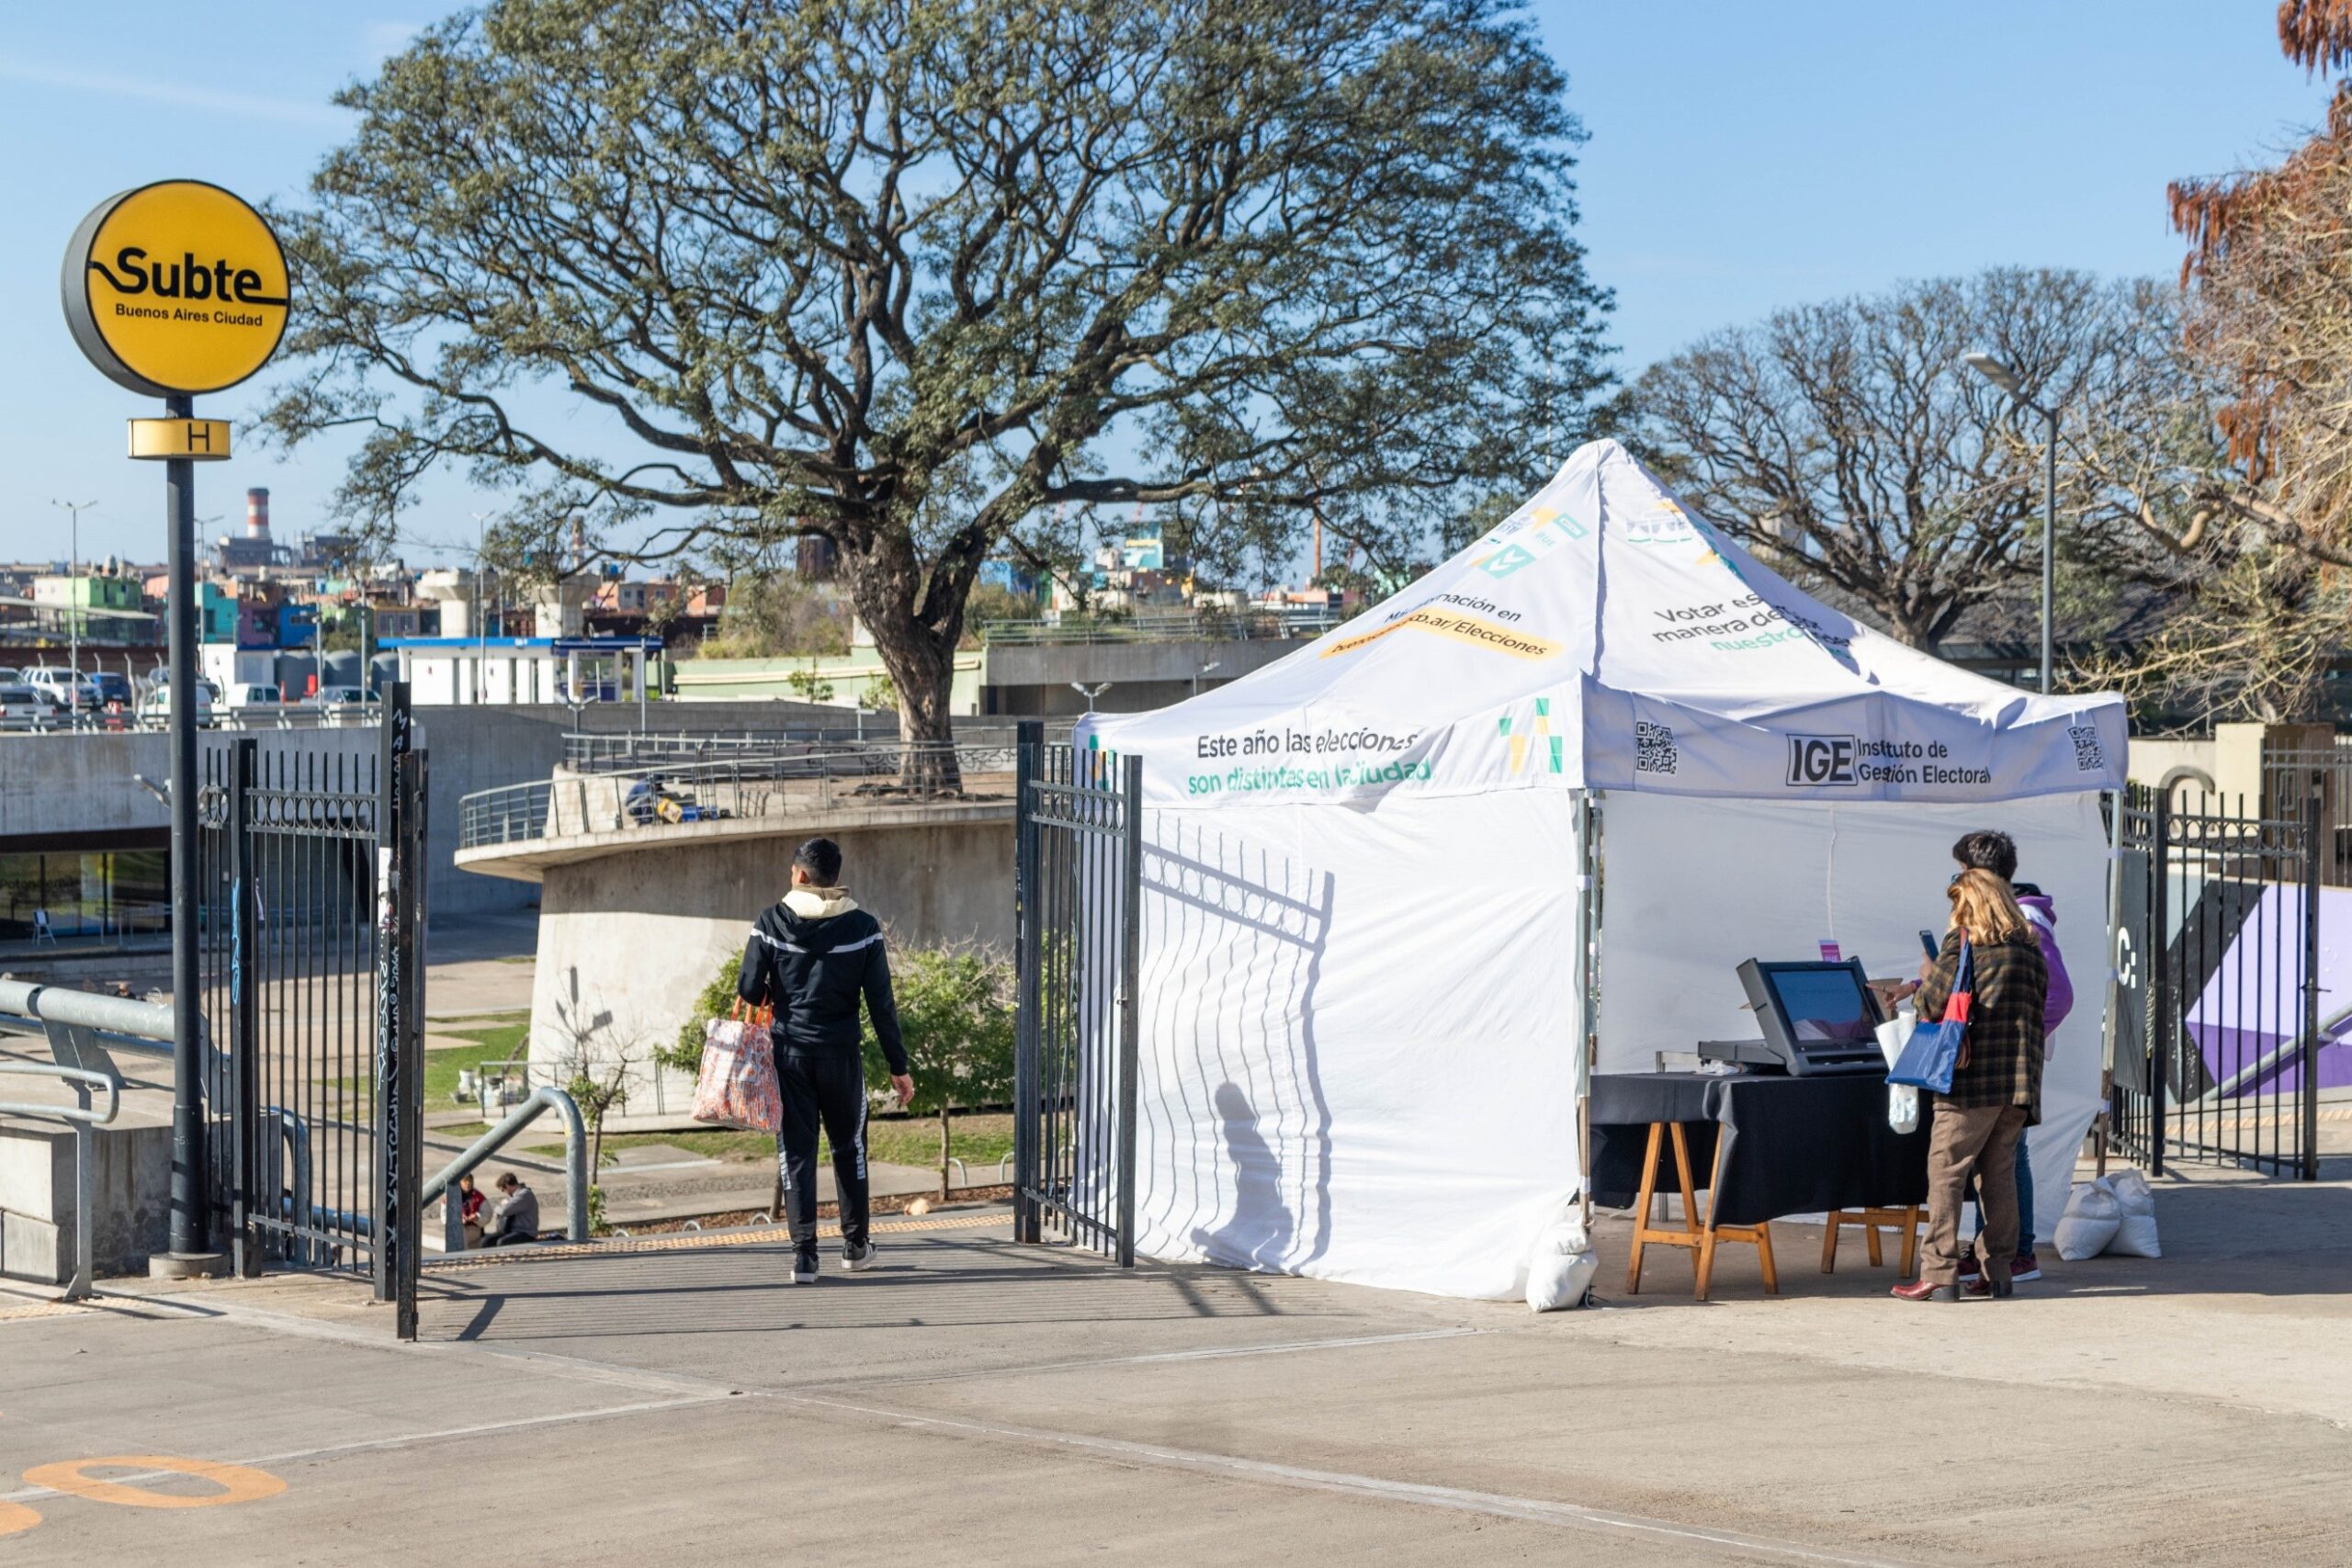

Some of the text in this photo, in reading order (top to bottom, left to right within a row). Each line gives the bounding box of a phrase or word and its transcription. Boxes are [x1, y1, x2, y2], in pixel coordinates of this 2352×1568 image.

[90, 246, 287, 307] Subte
[115, 303, 263, 327] Buenos Aires Ciudad
[187, 423, 209, 452] H
[1498, 609, 1522, 622] en
[1653, 602, 1727, 623] Votar
[1652, 618, 1748, 642] manera
[1197, 727, 1418, 758] Este año las elecciones
[1928, 739, 1949, 758] de
[1792, 739, 1853, 783] IGE
[1188, 773, 1222, 795] son
[1227, 765, 1304, 792] distintas
[1306, 772, 1329, 790] en
[1858, 763, 1991, 784] Gestión Electoral
